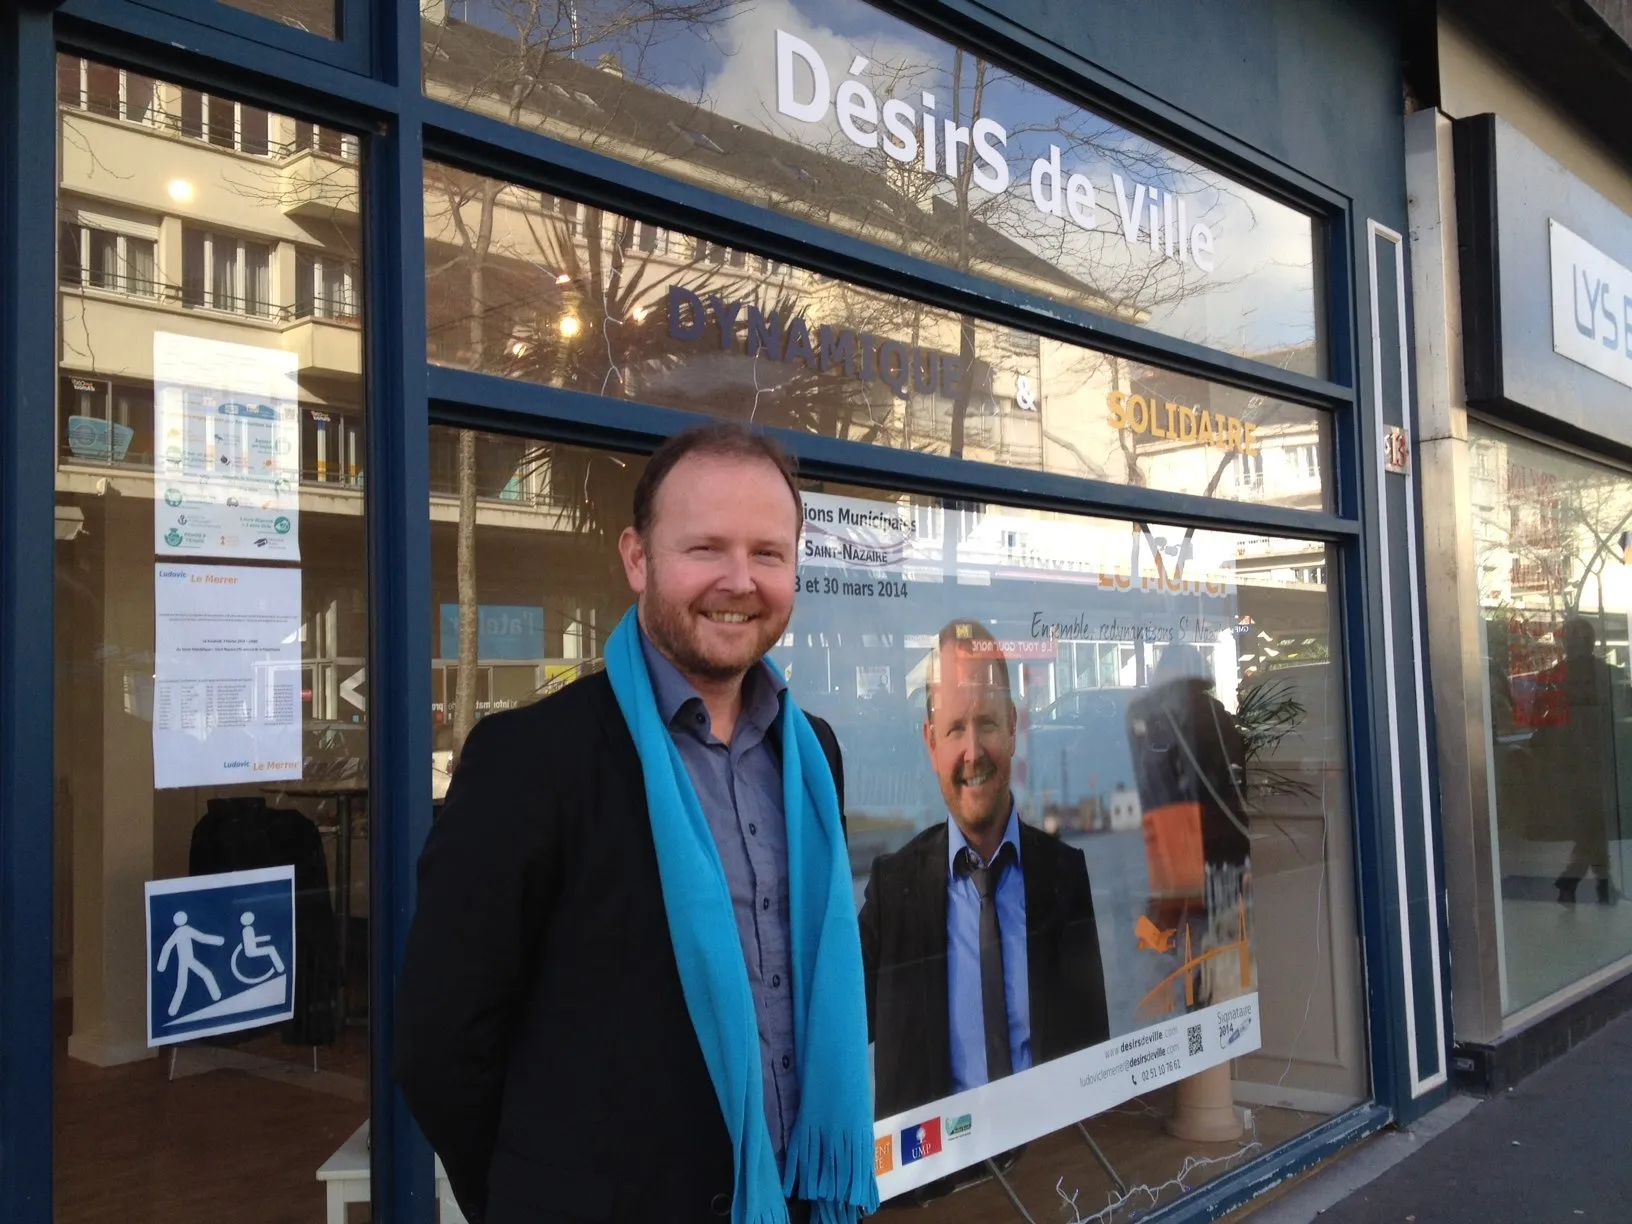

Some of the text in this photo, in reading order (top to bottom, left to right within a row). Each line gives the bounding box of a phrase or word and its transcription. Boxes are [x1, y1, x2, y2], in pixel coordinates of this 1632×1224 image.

[776, 28, 1215, 272] DésirS de Ville
[667, 284, 1258, 457] DYNAMIQUE & SOLIDAIRE
[803, 502, 834, 523] ions
[159, 570, 239, 585] Ludovic Le Merrer
[806, 577, 820, 594] et
[823, 578, 839, 594] 30
[843, 582, 874, 597] mars
[878, 581, 908, 598] 2014
[223, 760, 299, 771] Ludovic Le Merrer
[1217, 1004, 1252, 1024] Signataire
[1219, 1022, 1234, 1037] 2014
[1150, 1066, 1158, 1079] 51
[1159, 1063, 1166, 1076] 10
[1174, 1058, 1181, 1071] 61
[911, 1143, 932, 1160] UMP
